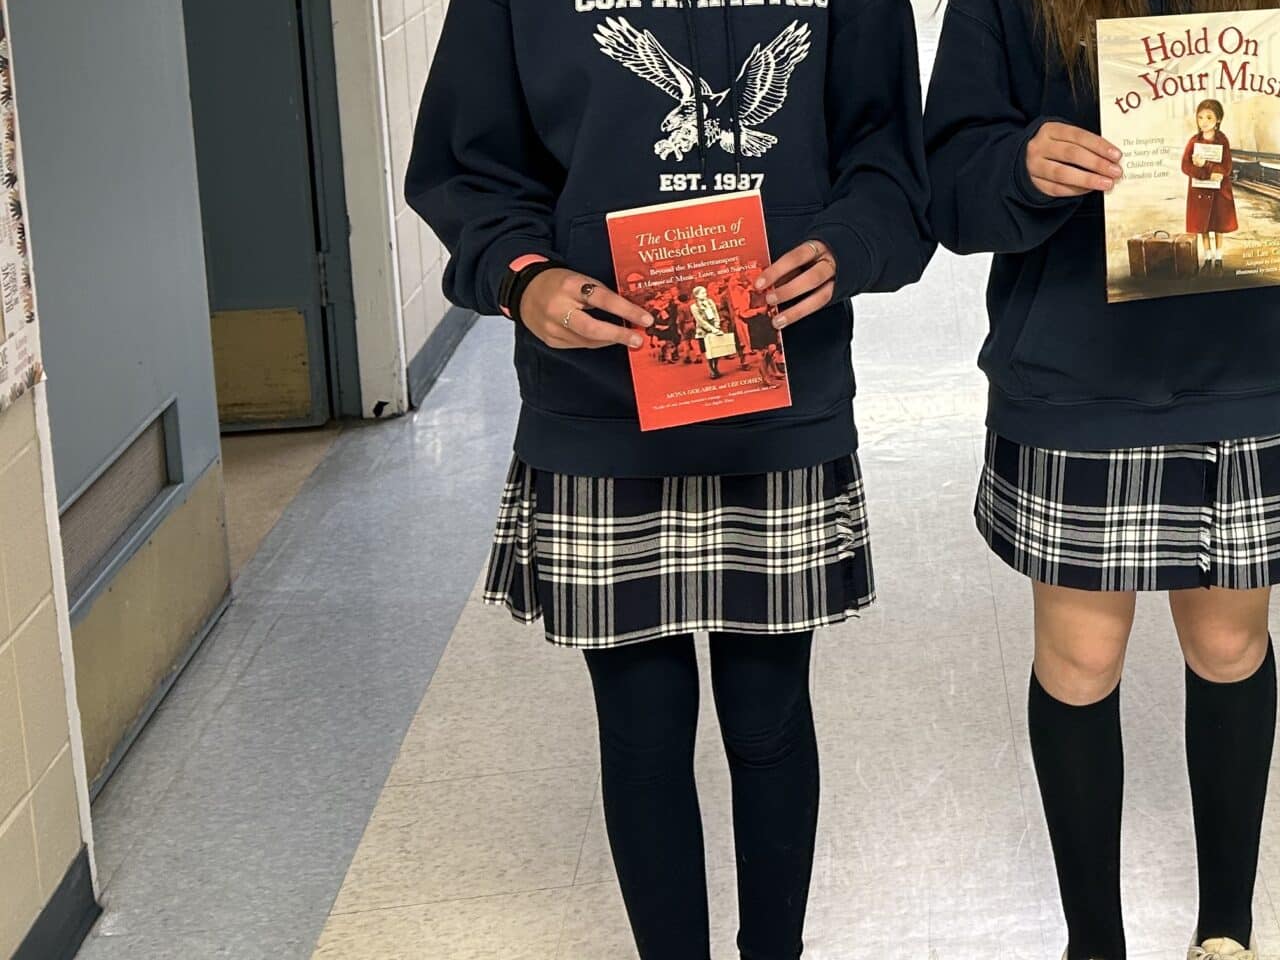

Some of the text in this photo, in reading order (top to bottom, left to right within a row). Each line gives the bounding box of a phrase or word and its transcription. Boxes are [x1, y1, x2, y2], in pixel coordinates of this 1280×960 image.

[1141, 26, 1259, 66] Hold On
[1114, 91, 1141, 114] to
[1137, 68, 1209, 101] Your
[659, 173, 765, 191] EST. 1987
[636, 217, 744, 247] The Children of
[638, 237, 746, 263] Willesden Lane
